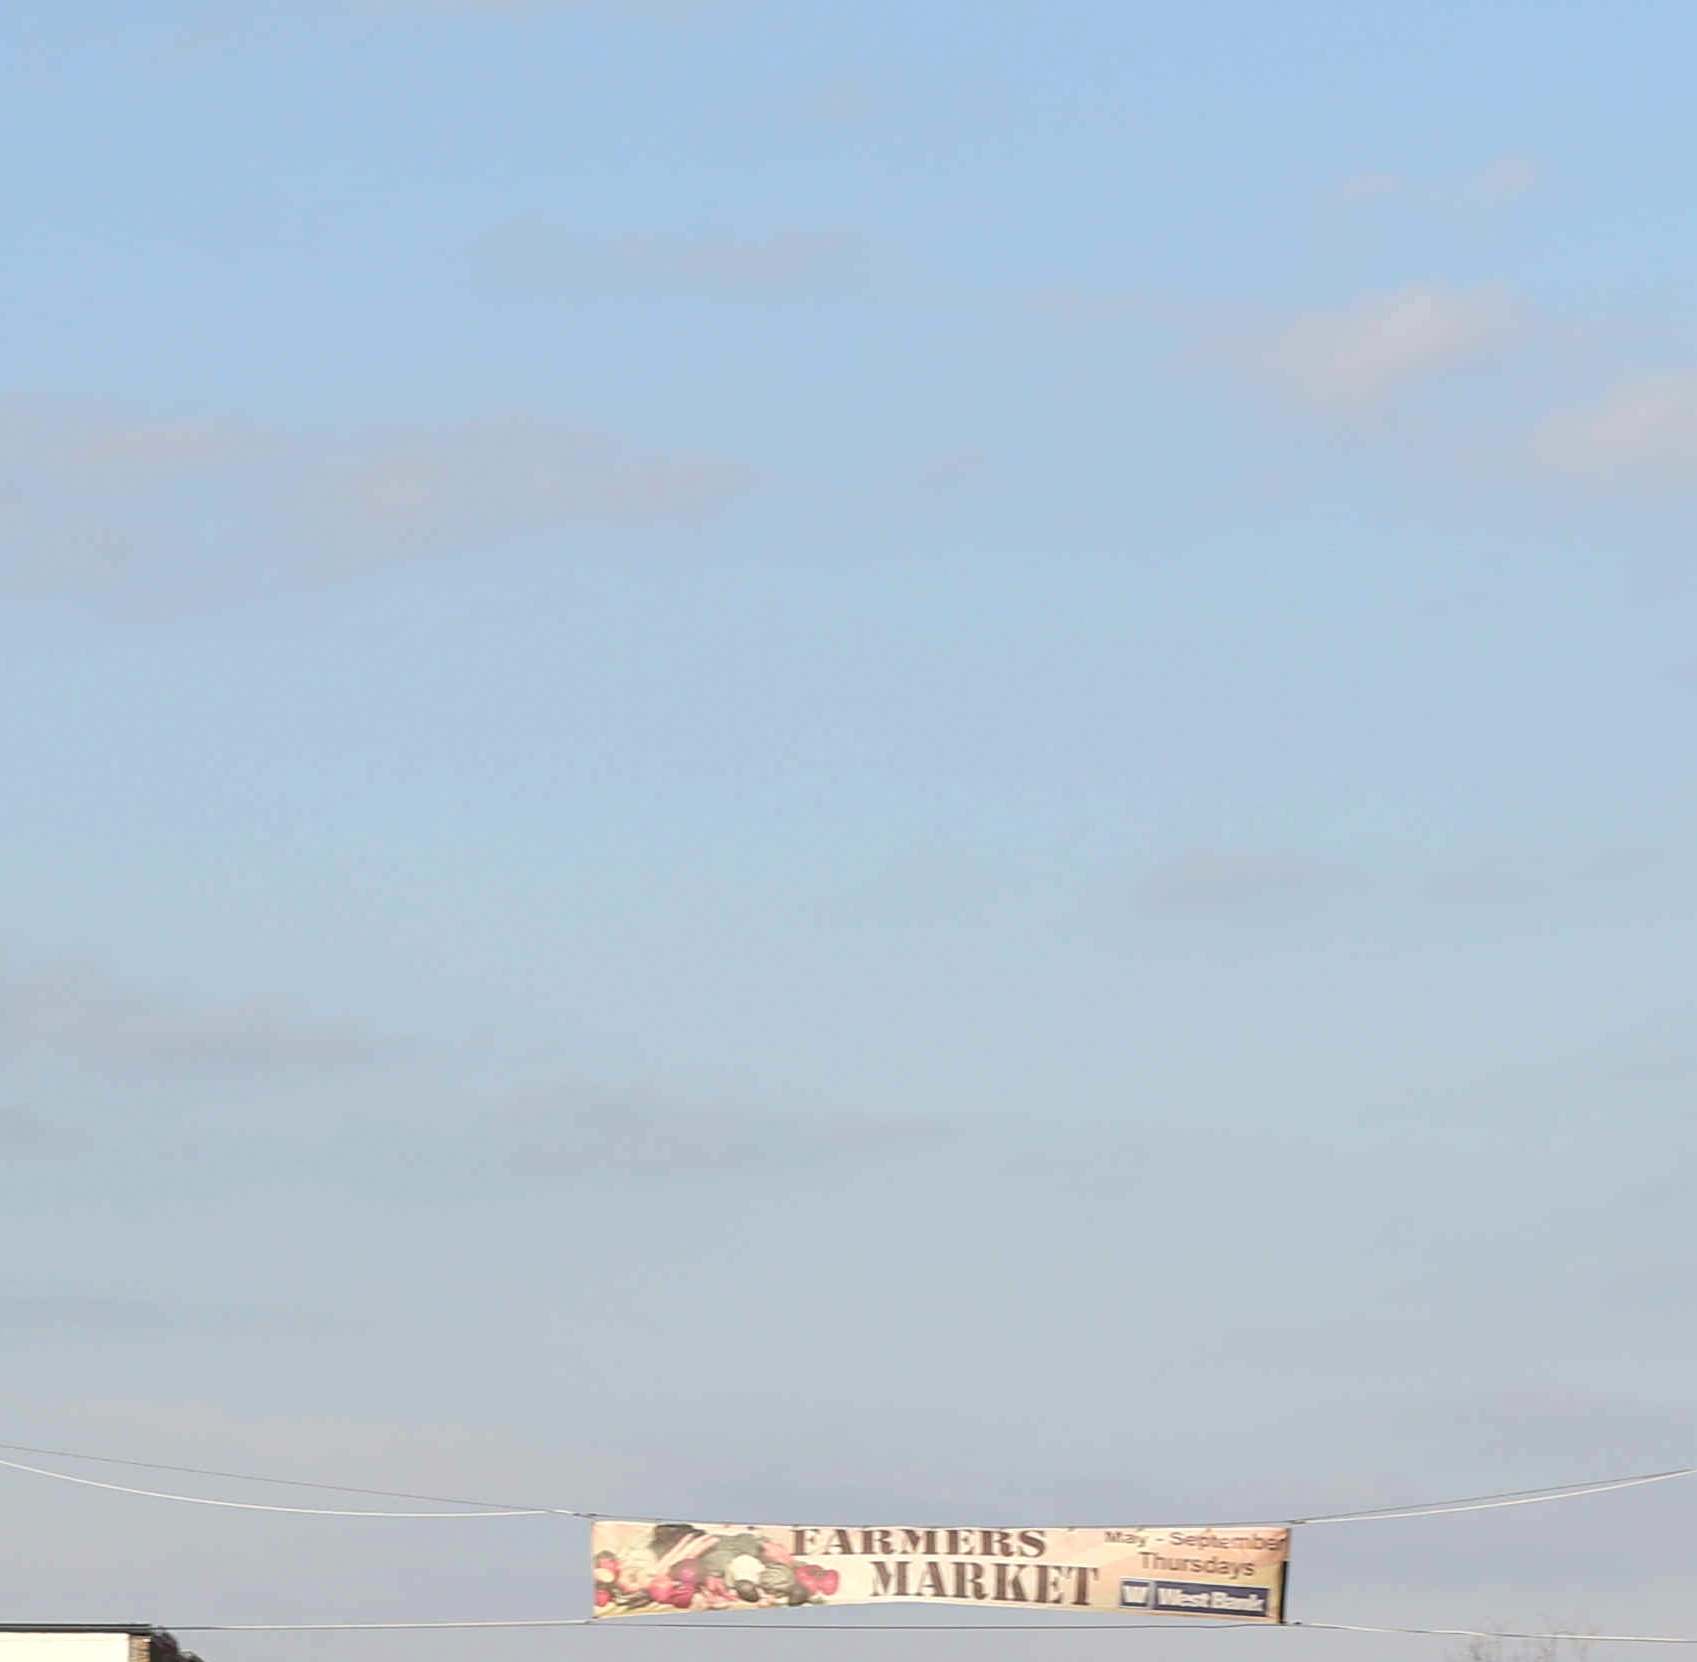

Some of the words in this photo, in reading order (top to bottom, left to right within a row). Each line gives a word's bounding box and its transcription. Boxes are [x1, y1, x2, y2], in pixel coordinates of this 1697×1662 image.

[790, 1529, 1047, 1557] FARMERS
[1104, 1531, 1148, 1547] May
[1169, 1532, 1288, 1551] September
[1139, 1551, 1256, 1579] Thursdays
[870, 1561, 1099, 1606] MARKET
[1158, 1588, 1210, 1607] West
[1211, 1591, 1264, 1612] Bank
